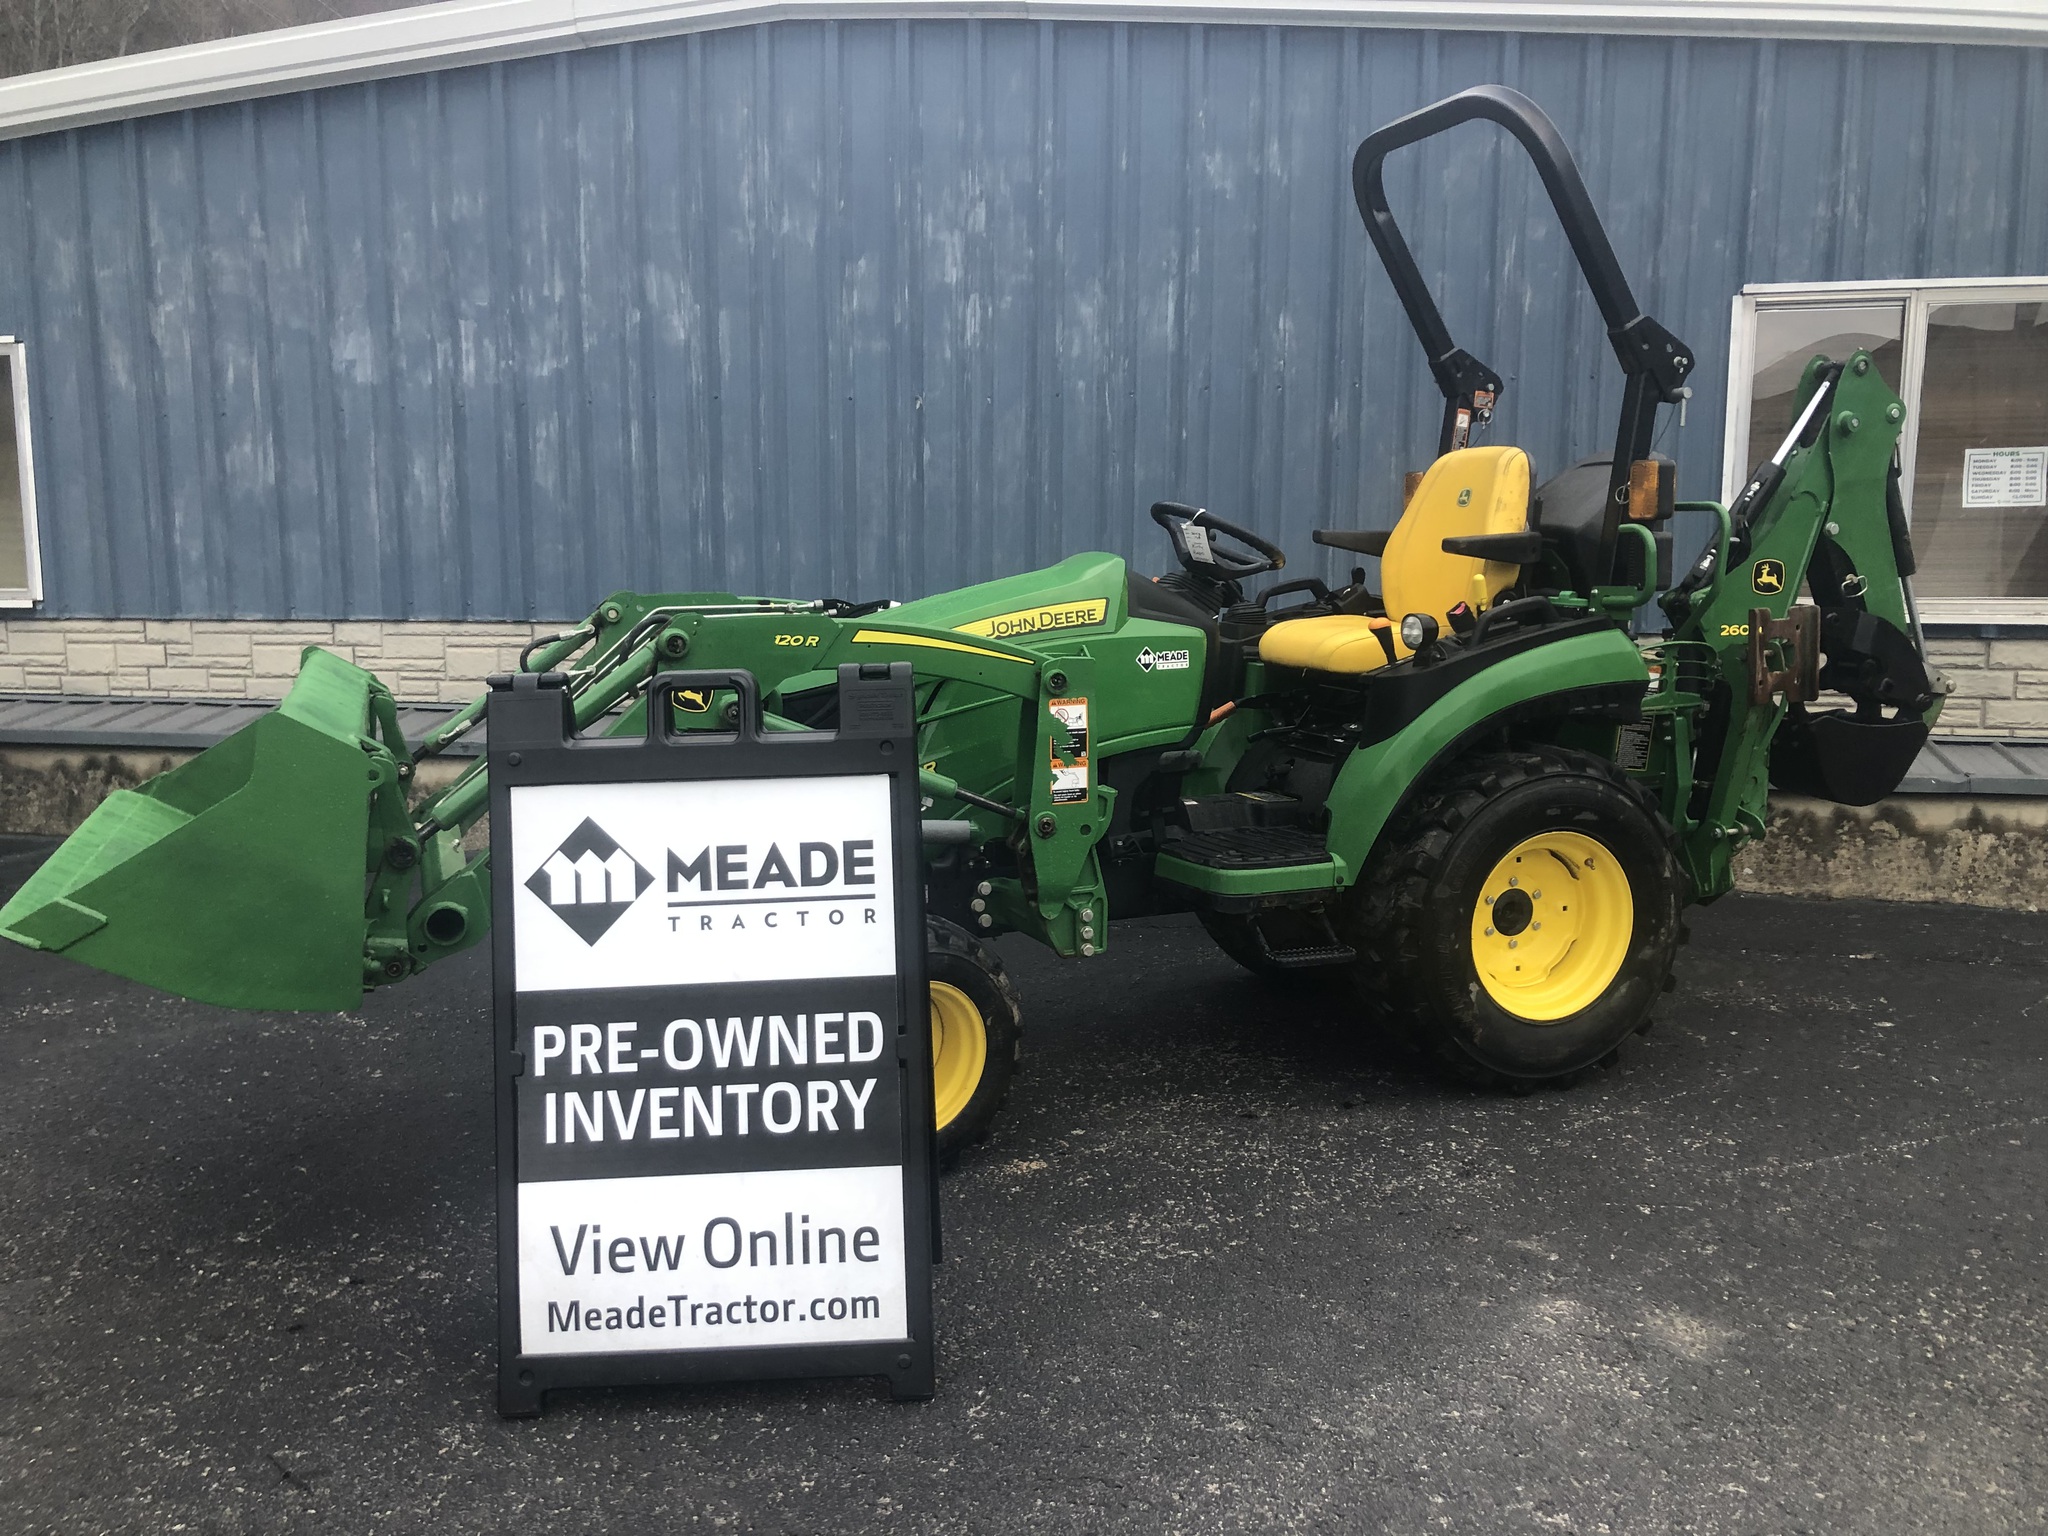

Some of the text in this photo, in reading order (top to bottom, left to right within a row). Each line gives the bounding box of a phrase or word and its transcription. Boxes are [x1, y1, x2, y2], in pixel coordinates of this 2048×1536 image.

[986, 608, 1098, 637] JOHN DEERE
[1157, 651, 1188, 661] MEADE
[666, 839, 876, 893] MEADE
[667, 907, 877, 932] TRACTOR
[533, 1010, 885, 1077] PRE-OWNED
[544, 1078, 878, 1145] INVENTORY
[550, 1212, 880, 1276] View Online
[547, 1294, 881, 1333] MeadeTractor.com
